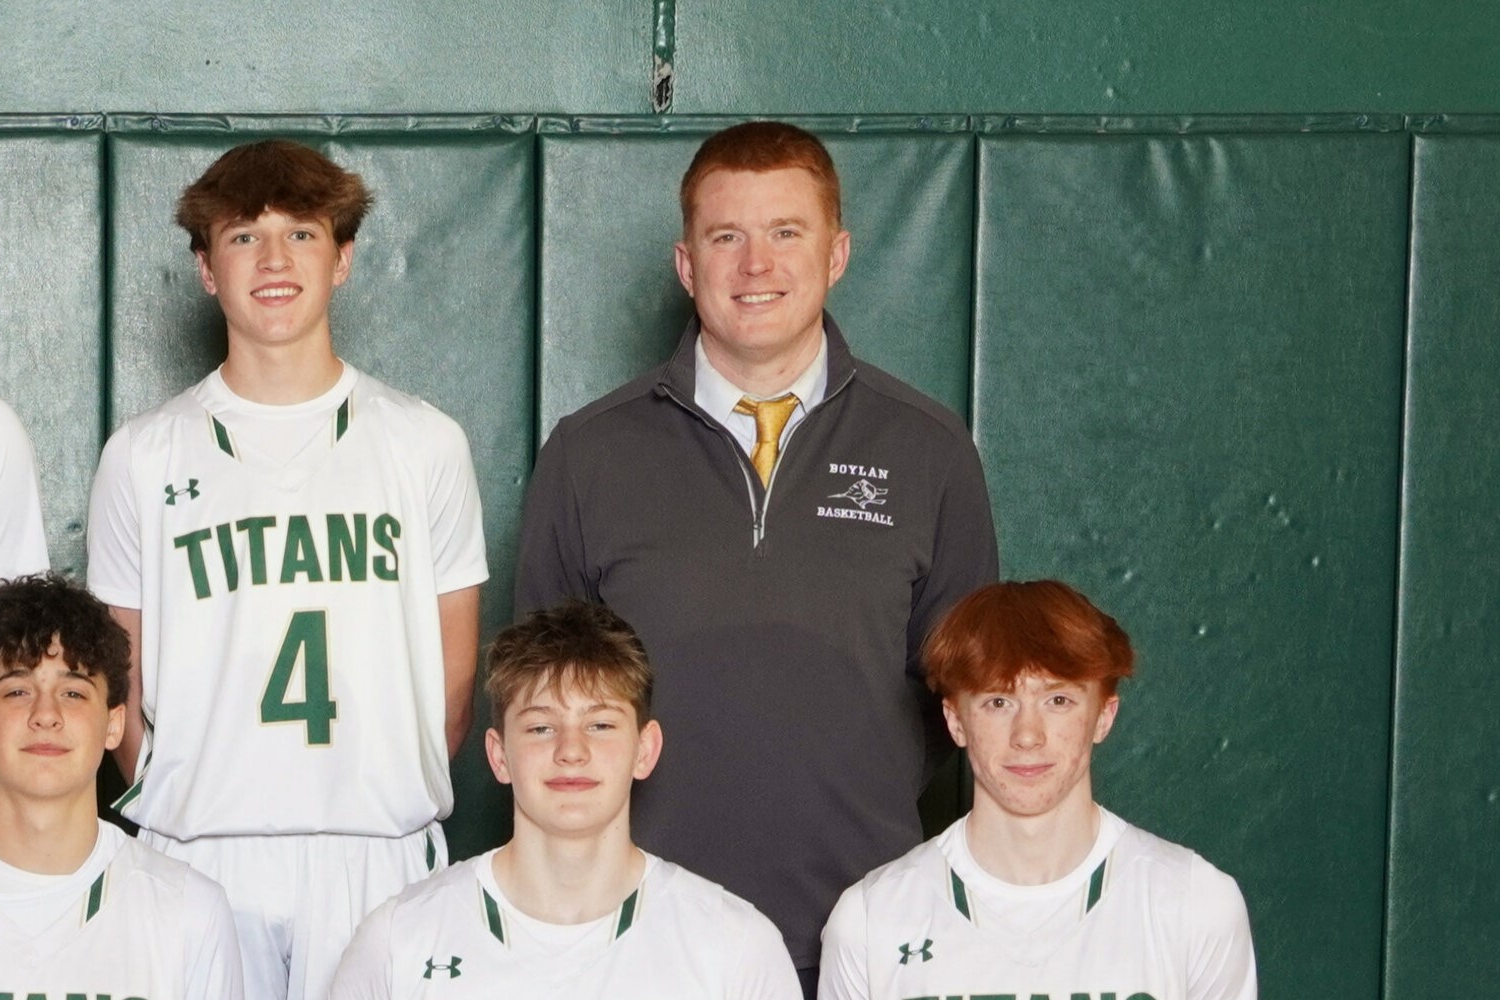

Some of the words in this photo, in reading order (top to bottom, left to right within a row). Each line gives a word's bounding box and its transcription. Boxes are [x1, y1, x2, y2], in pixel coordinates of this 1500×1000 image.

[829, 463, 889, 479] BOYLAN
[817, 506, 894, 526] BASKETBALL
[174, 512, 401, 600] TITANS
[258, 607, 339, 748] 4
